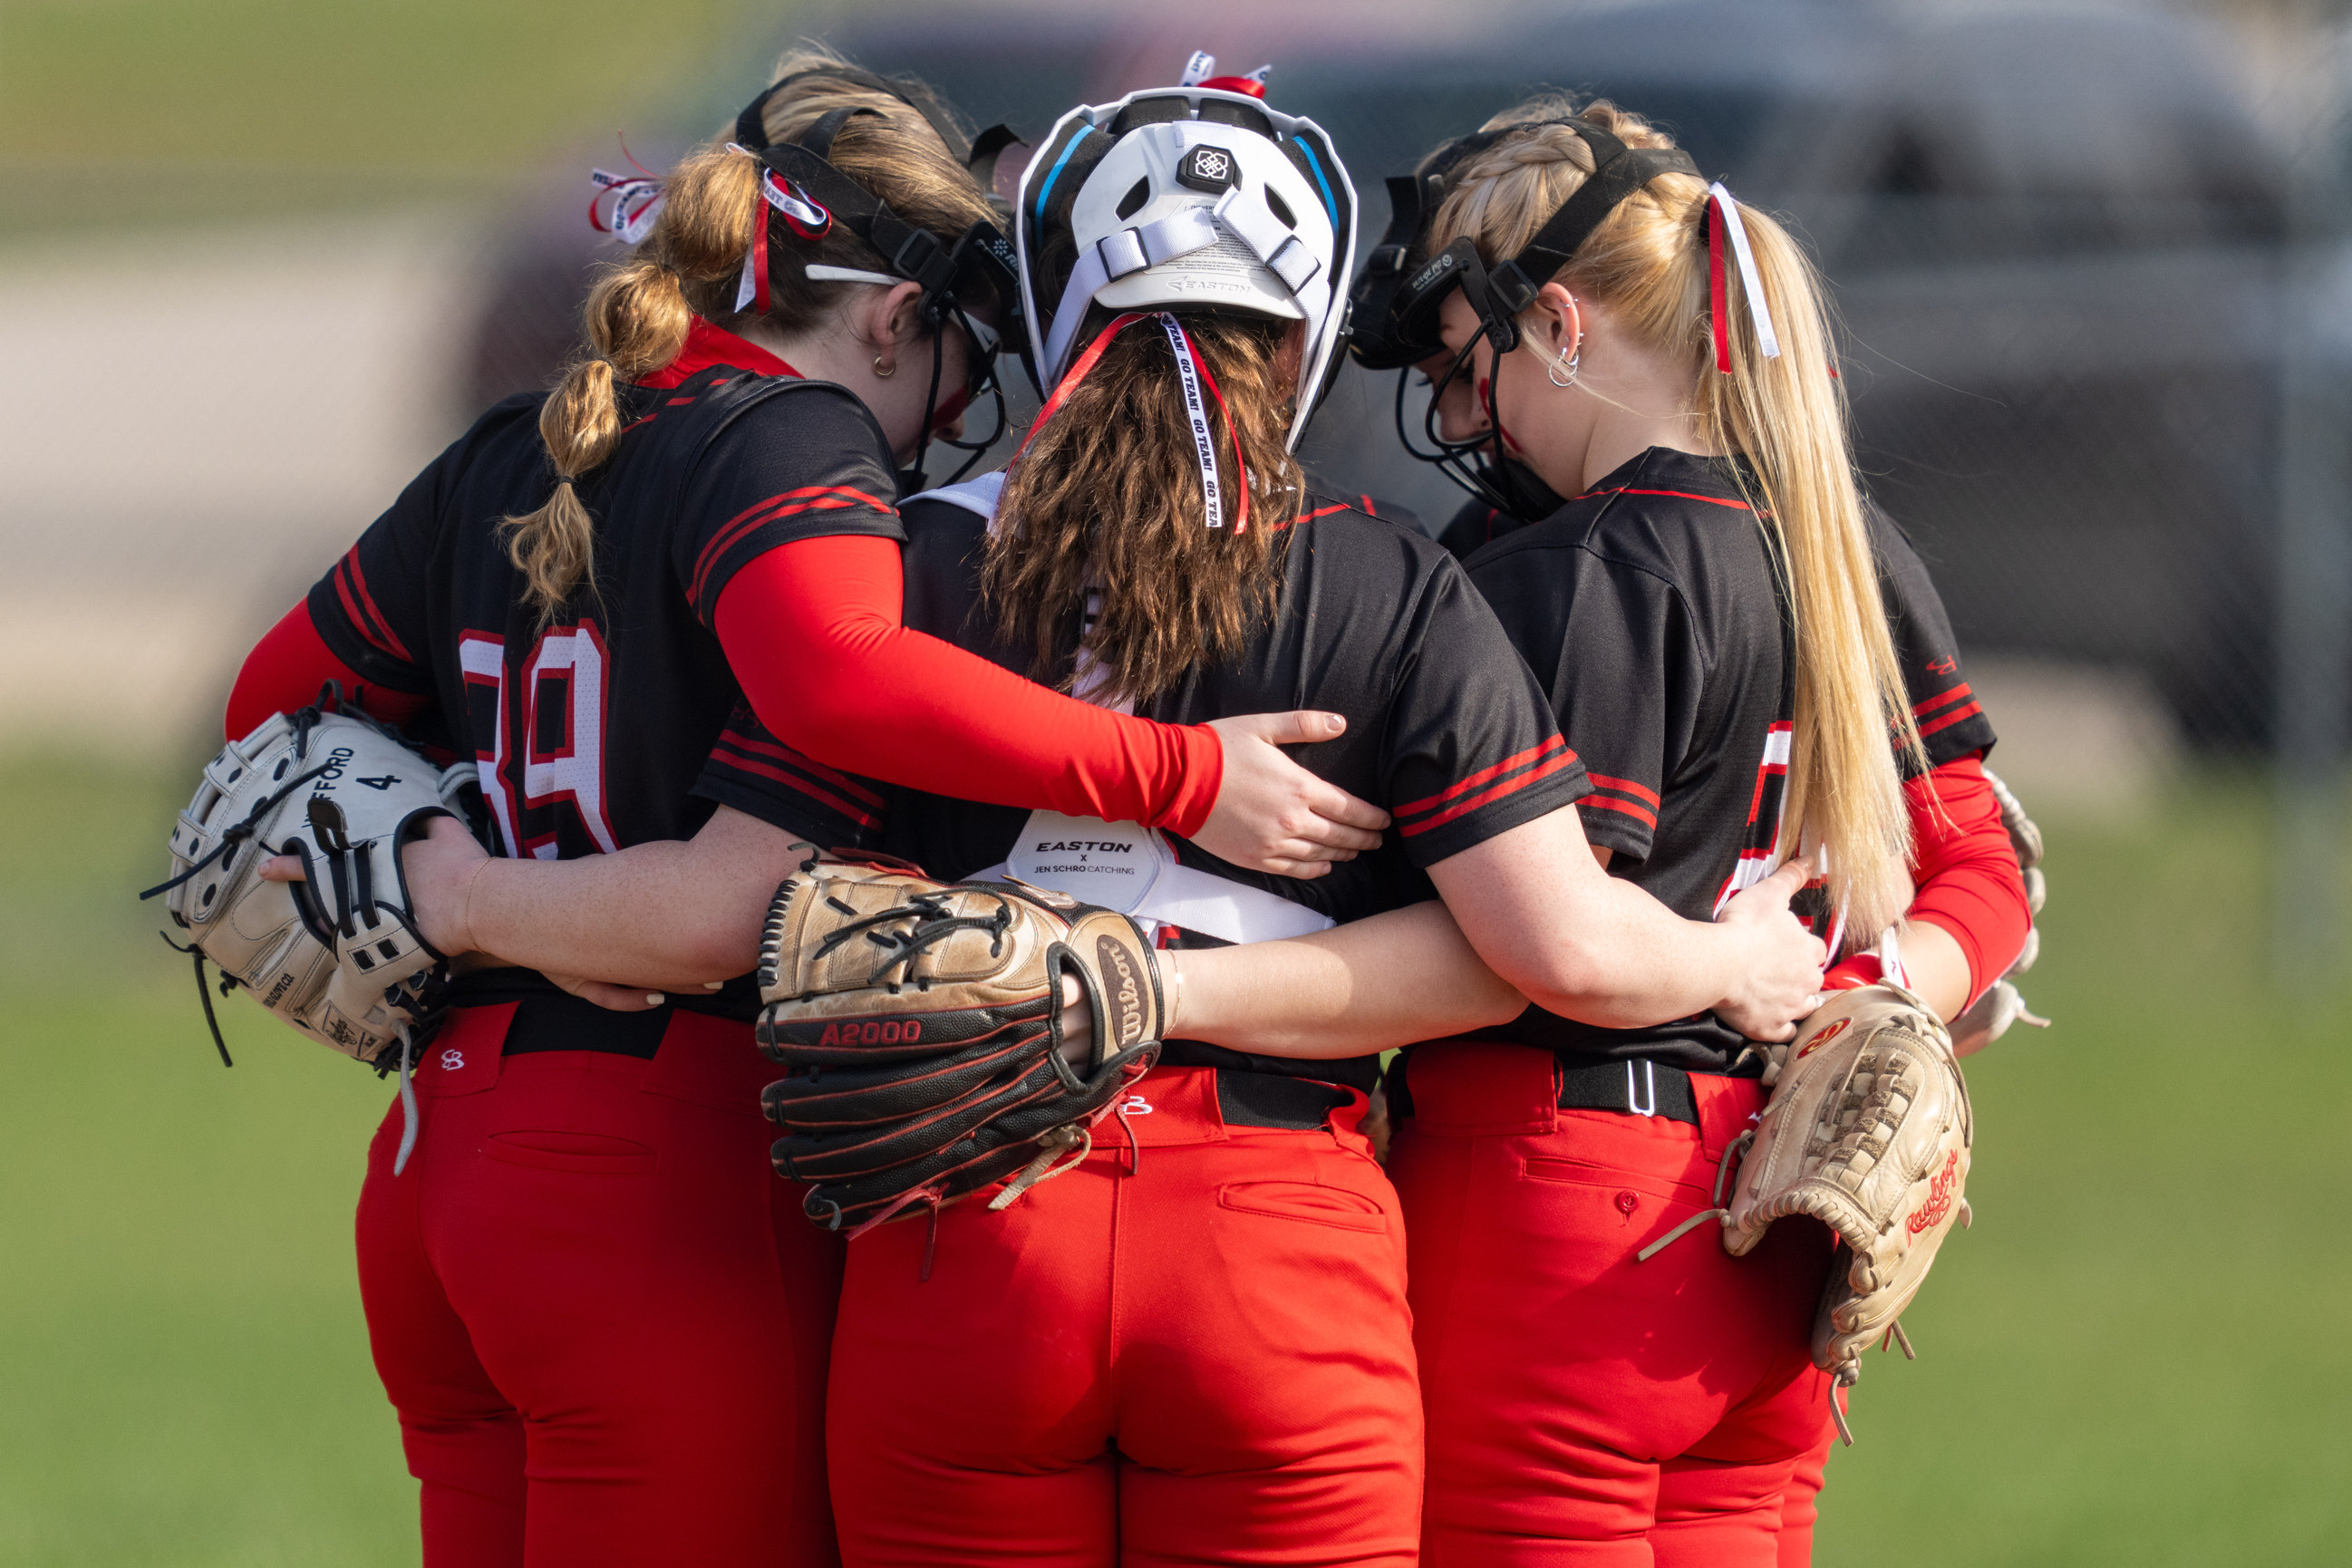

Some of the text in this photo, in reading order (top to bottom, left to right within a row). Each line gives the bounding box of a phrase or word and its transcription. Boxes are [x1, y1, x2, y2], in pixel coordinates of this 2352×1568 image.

[1186, 280, 1251, 293] EASTON
[1180, 358, 1192, 373] GO
[1184, 376, 1200, 411] TEAM!
[1193, 419, 1205, 434] GO
[1197, 436, 1214, 471] TEAM!
[1205, 480, 1216, 498] GO
[355, 774, 402, 791] 4
[1036, 841, 1133, 853] EASTON
[1034, 865, 1136, 875] JEN SCHRO CATCHING
[1108, 943, 1142, 1045] Wilson
[818, 1020, 922, 1048] A2000
[1904, 1148, 1959, 1248] Rawlings
